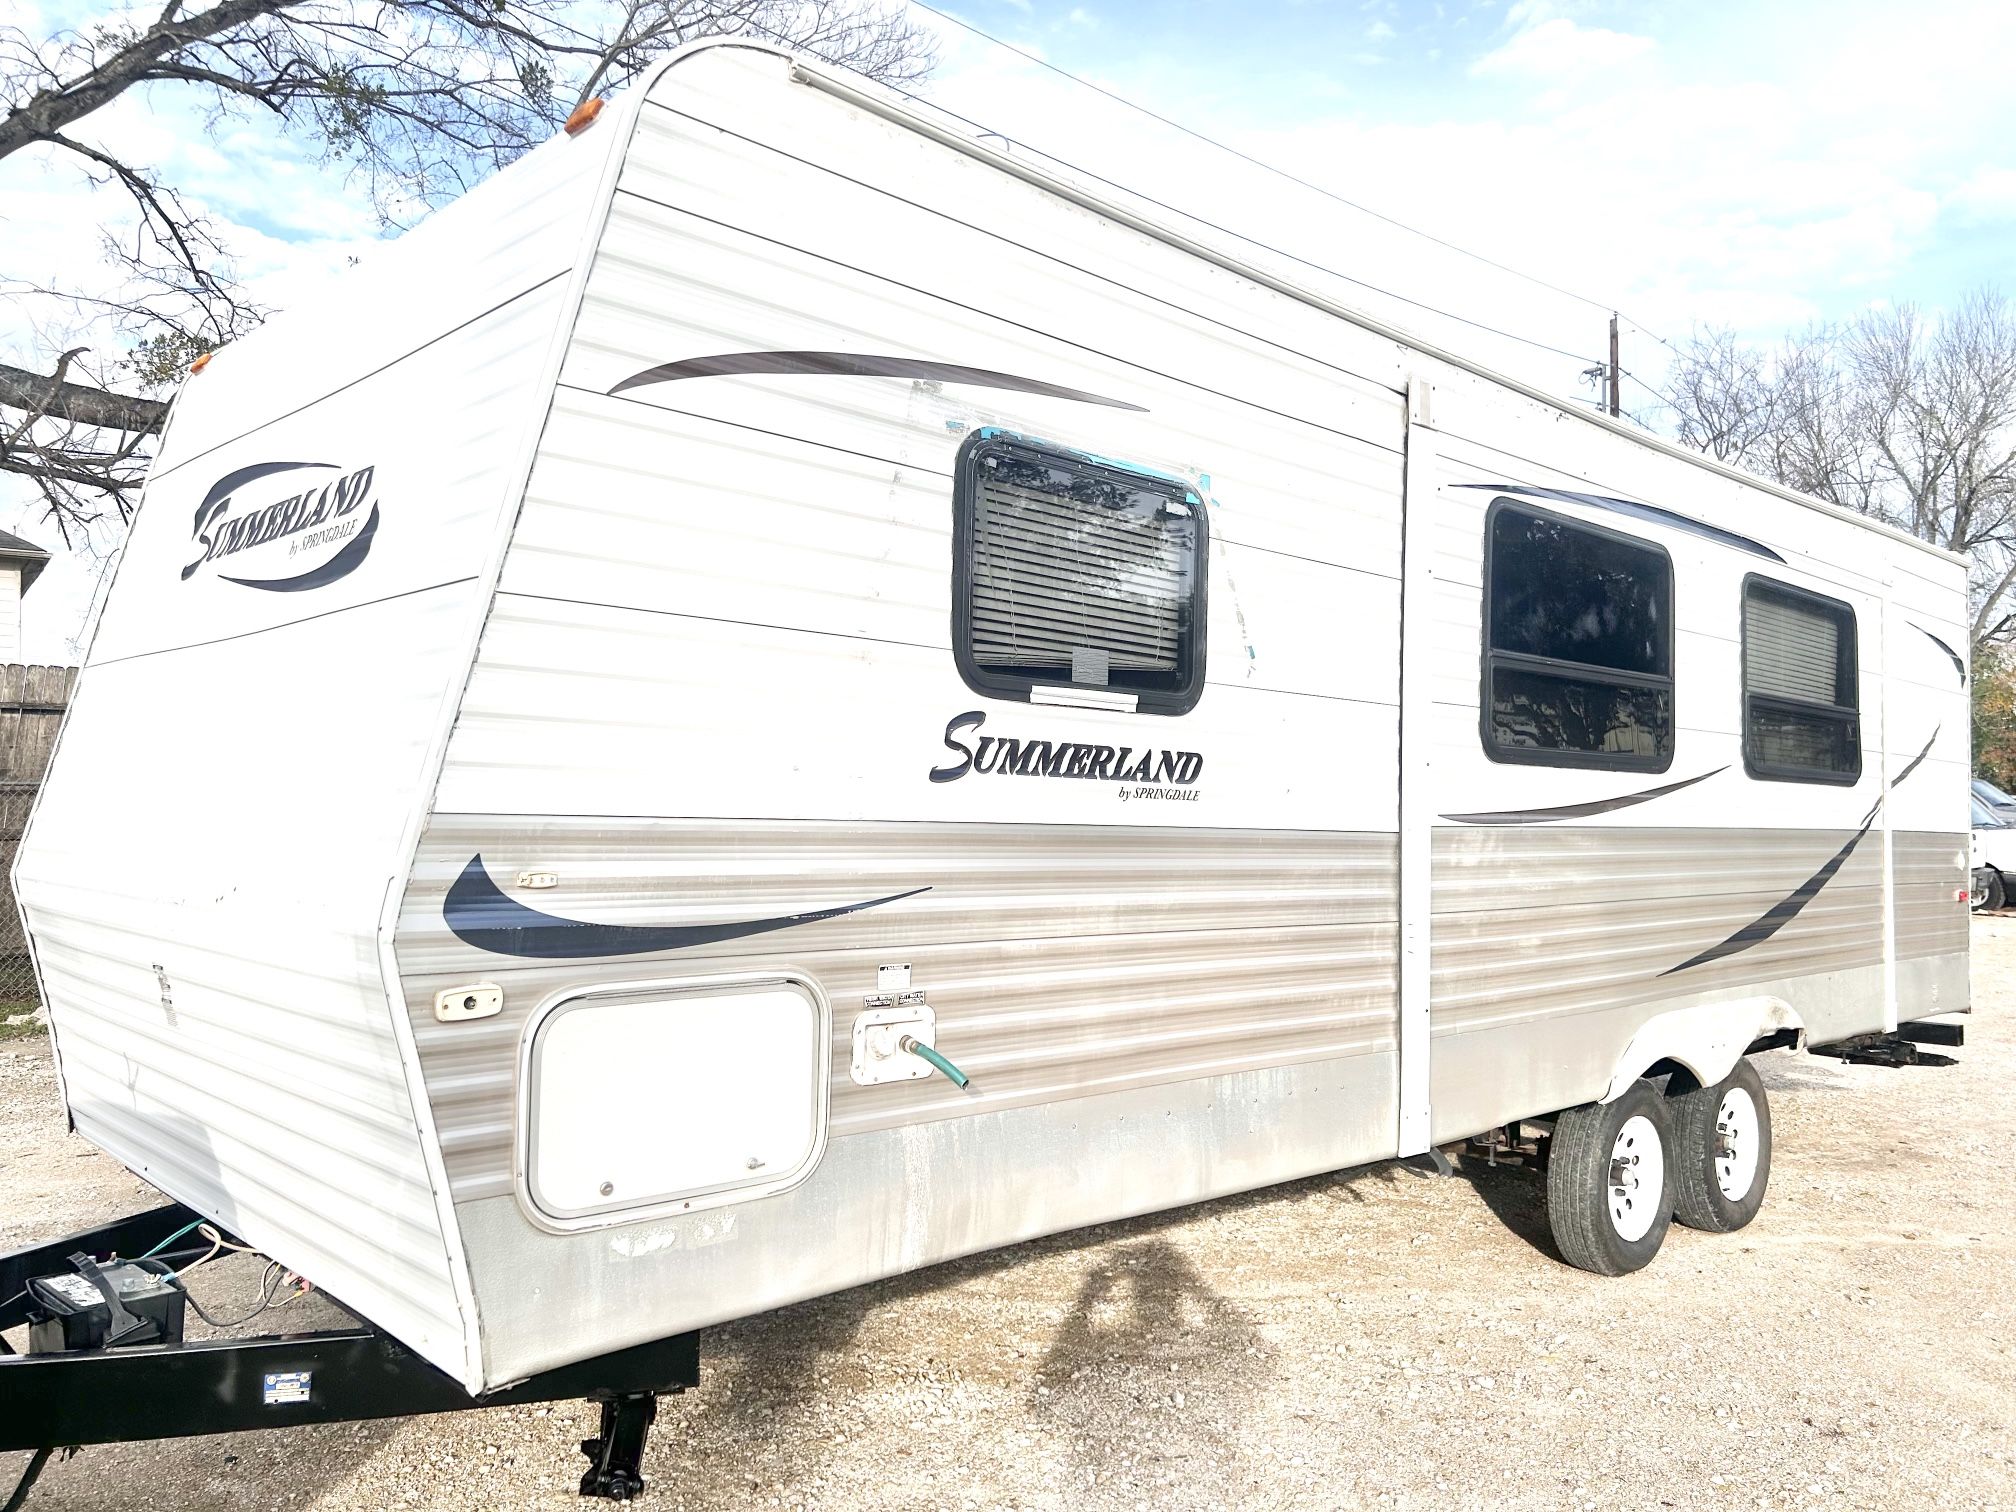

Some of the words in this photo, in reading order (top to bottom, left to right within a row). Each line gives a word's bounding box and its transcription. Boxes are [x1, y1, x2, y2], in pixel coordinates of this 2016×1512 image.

[181, 465, 375, 581] SUMMERLAND
[289, 540, 300, 560] by
[300, 518, 358, 551] SPRINGDALE
[929, 711, 1203, 784] SUMMERLAND
[1118, 786, 1131, 802] by
[1133, 787, 1200, 801] SPRINGDALE
